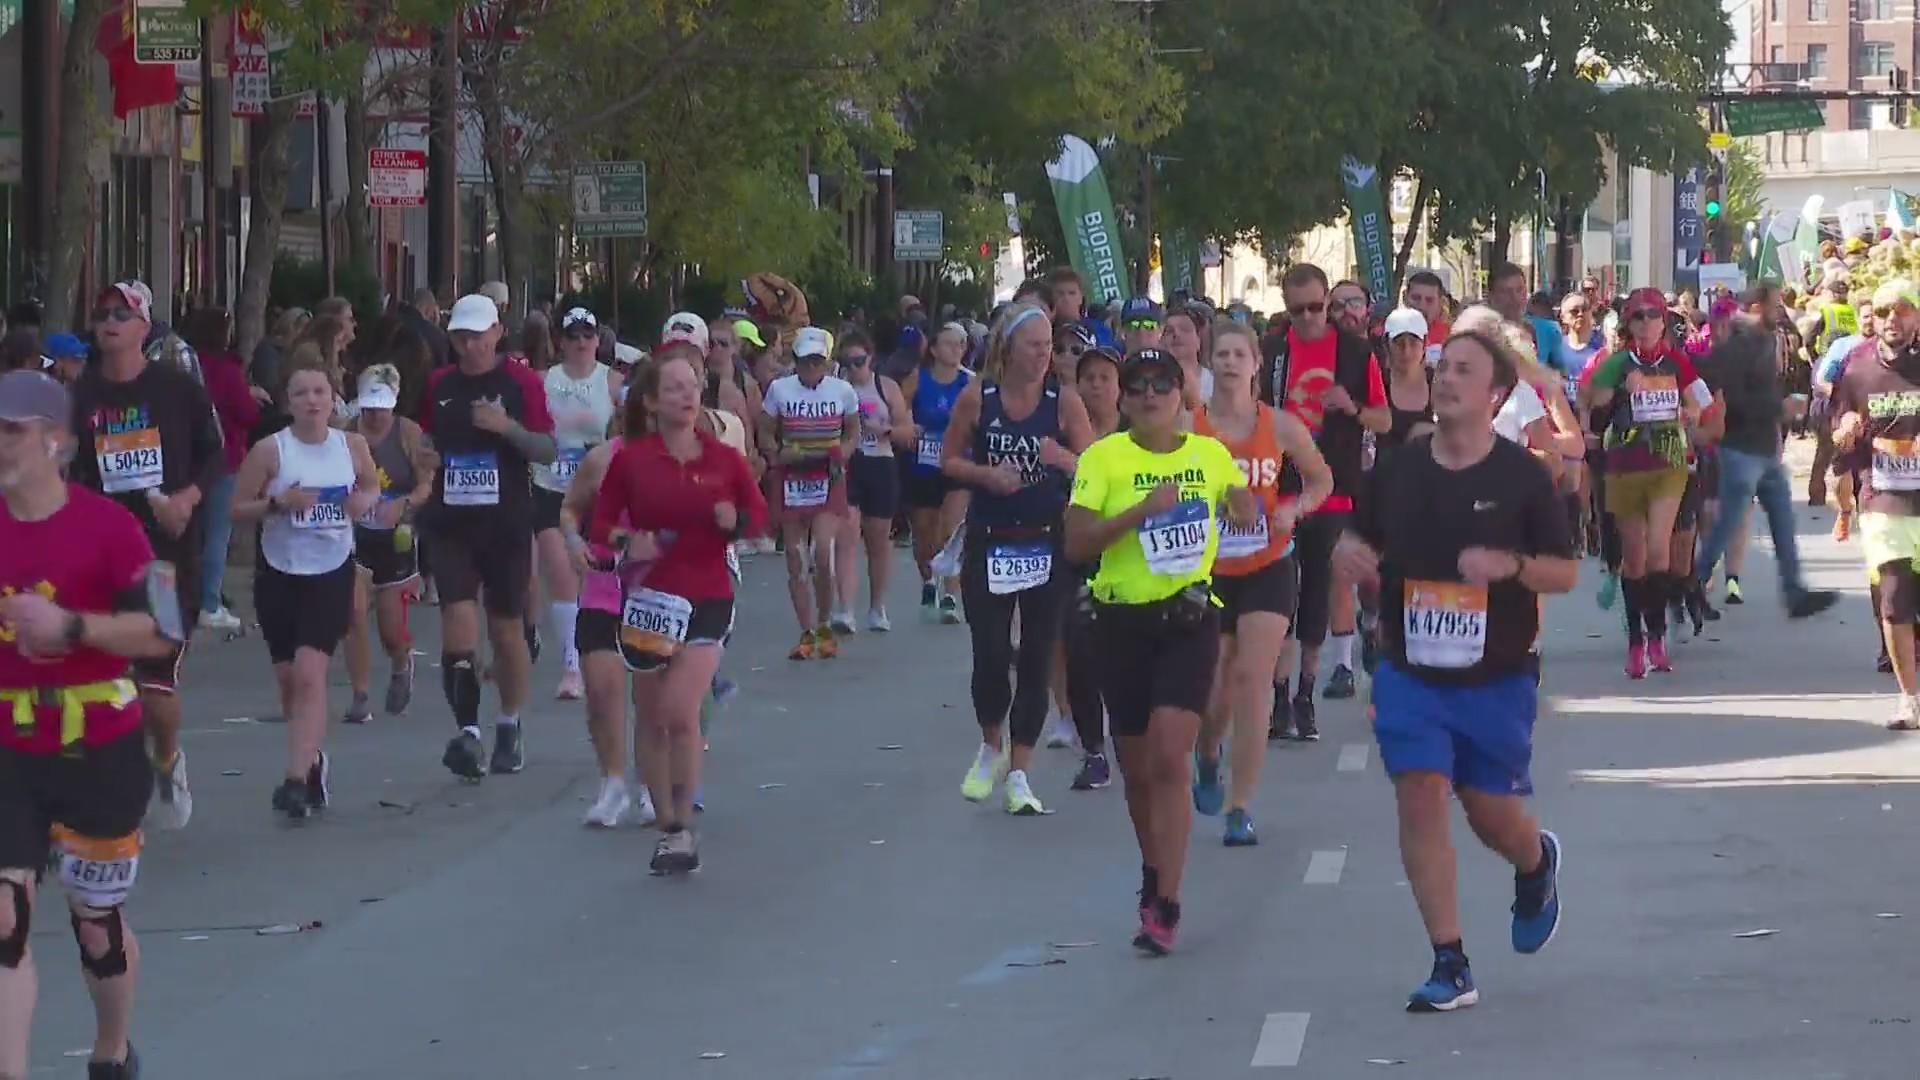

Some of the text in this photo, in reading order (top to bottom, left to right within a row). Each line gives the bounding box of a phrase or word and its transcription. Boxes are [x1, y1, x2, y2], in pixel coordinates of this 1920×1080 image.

[153, 48, 193, 59] 535 714
[373, 151, 406, 160] STREET
[373, 159, 419, 169] CLEANING
[612, 164, 641, 175] PARK
[373, 196, 392, 206] TOW
[786, 400, 838, 417] MÉXICO
[103, 447, 159, 472] L 50423
[458, 471, 496, 486] 35500
[1149, 530, 1159, 553] J
[1160, 522, 1206, 551] 37104
[992, 556, 1048, 576] G 26393
[627, 608, 672, 634] 50632
[1408, 606, 1419, 635] K
